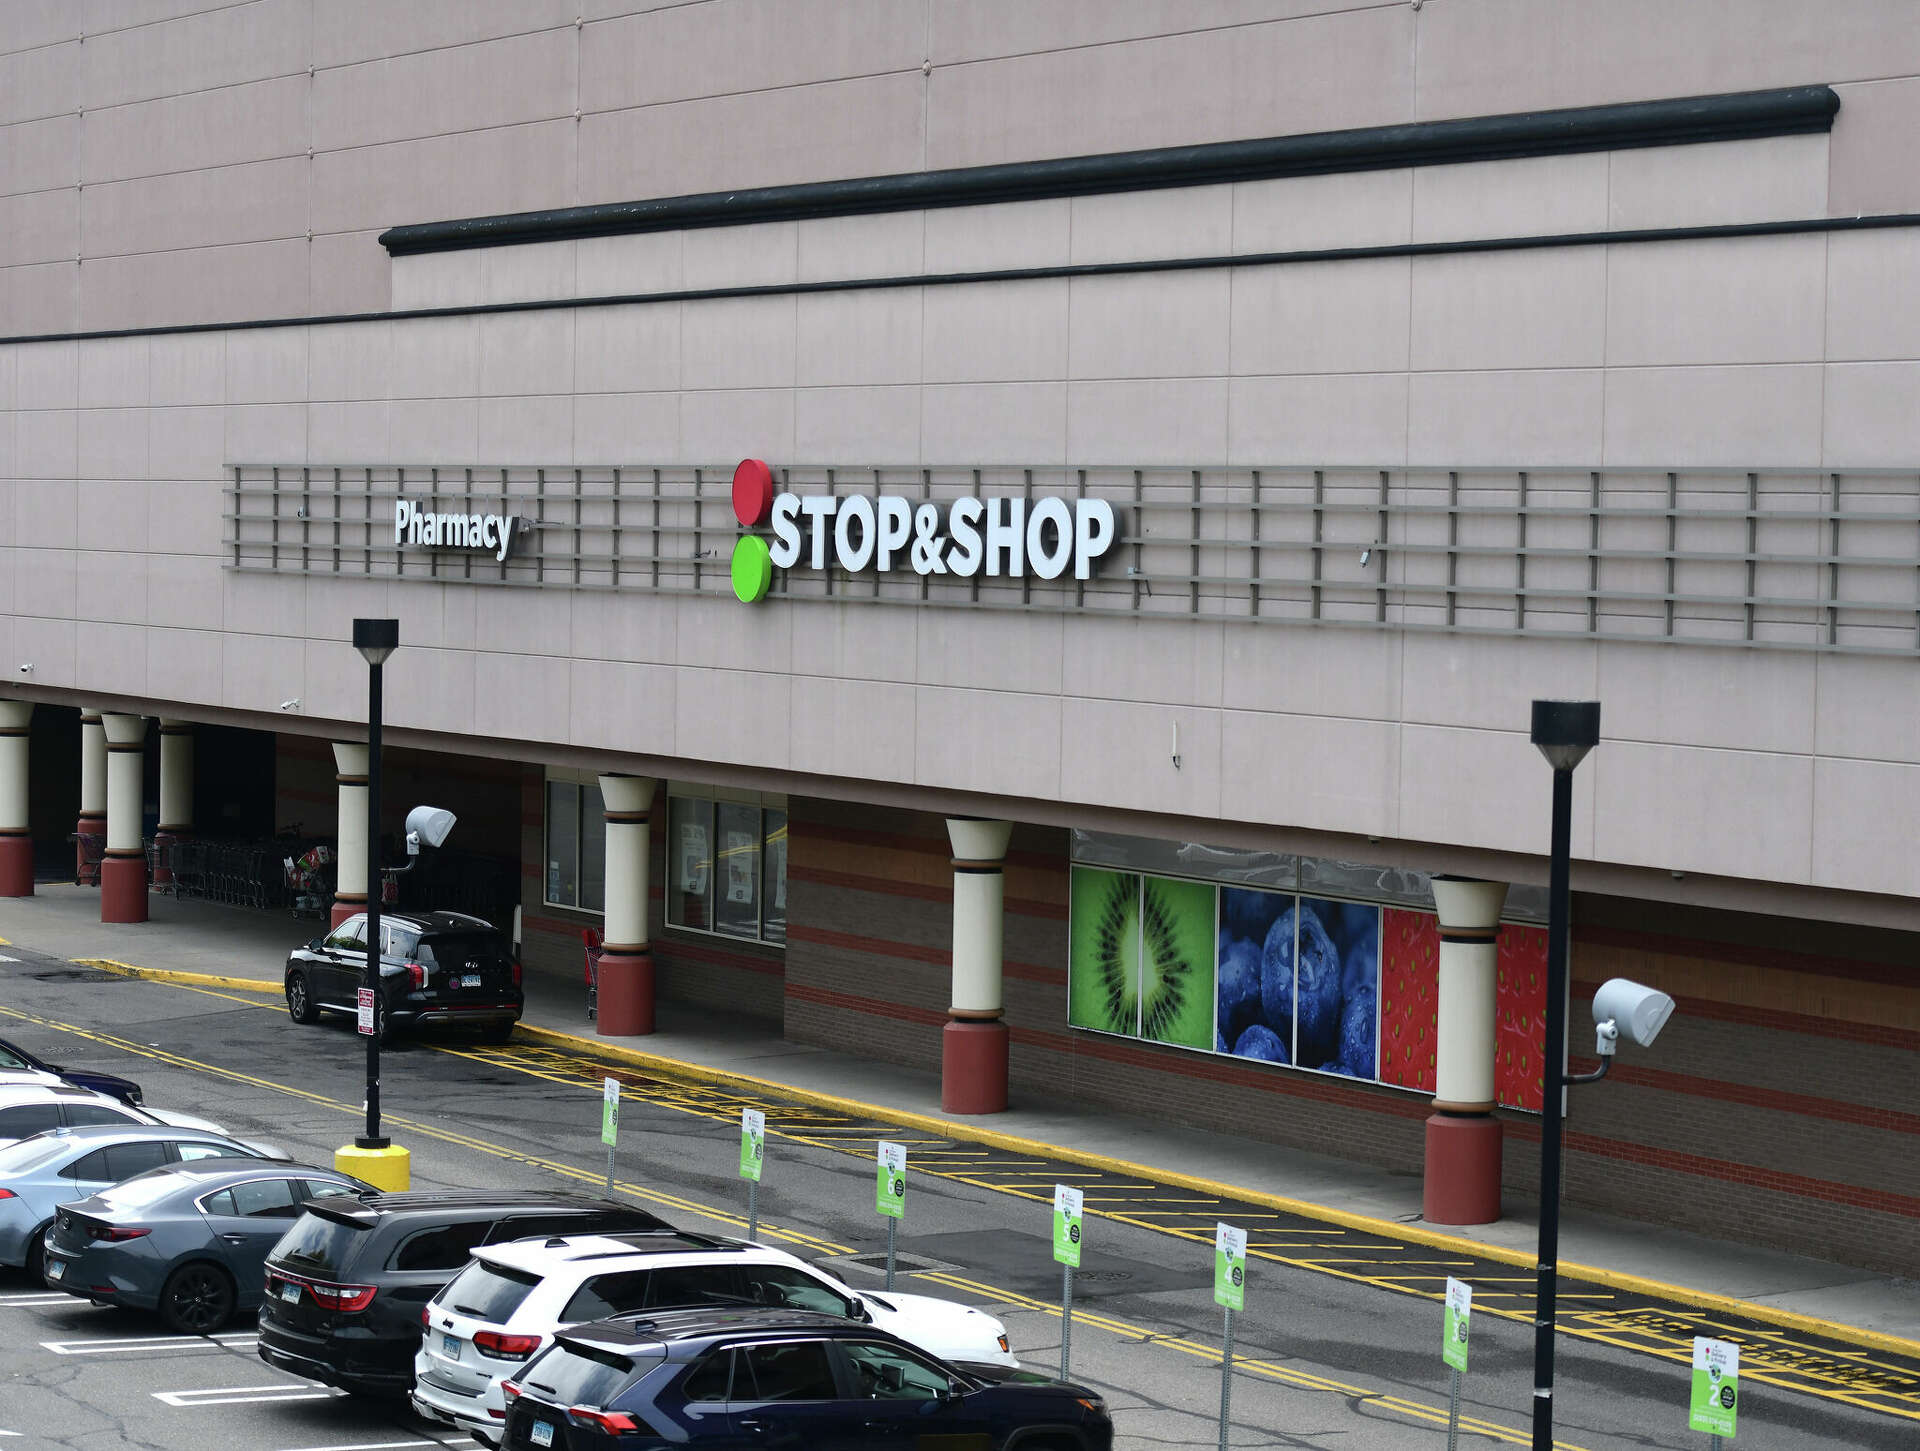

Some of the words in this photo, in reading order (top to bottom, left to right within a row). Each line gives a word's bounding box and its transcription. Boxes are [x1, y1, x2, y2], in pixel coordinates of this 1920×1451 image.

[395, 500, 512, 562] Pharmacy
[769, 492, 1115, 580] STOP&SHOP
[888, 1177, 895, 1195] 6
[1063, 1223, 1070, 1242] 5
[1224, 1265, 1232, 1284] 4
[1708, 1384, 1719, 1407] 2
